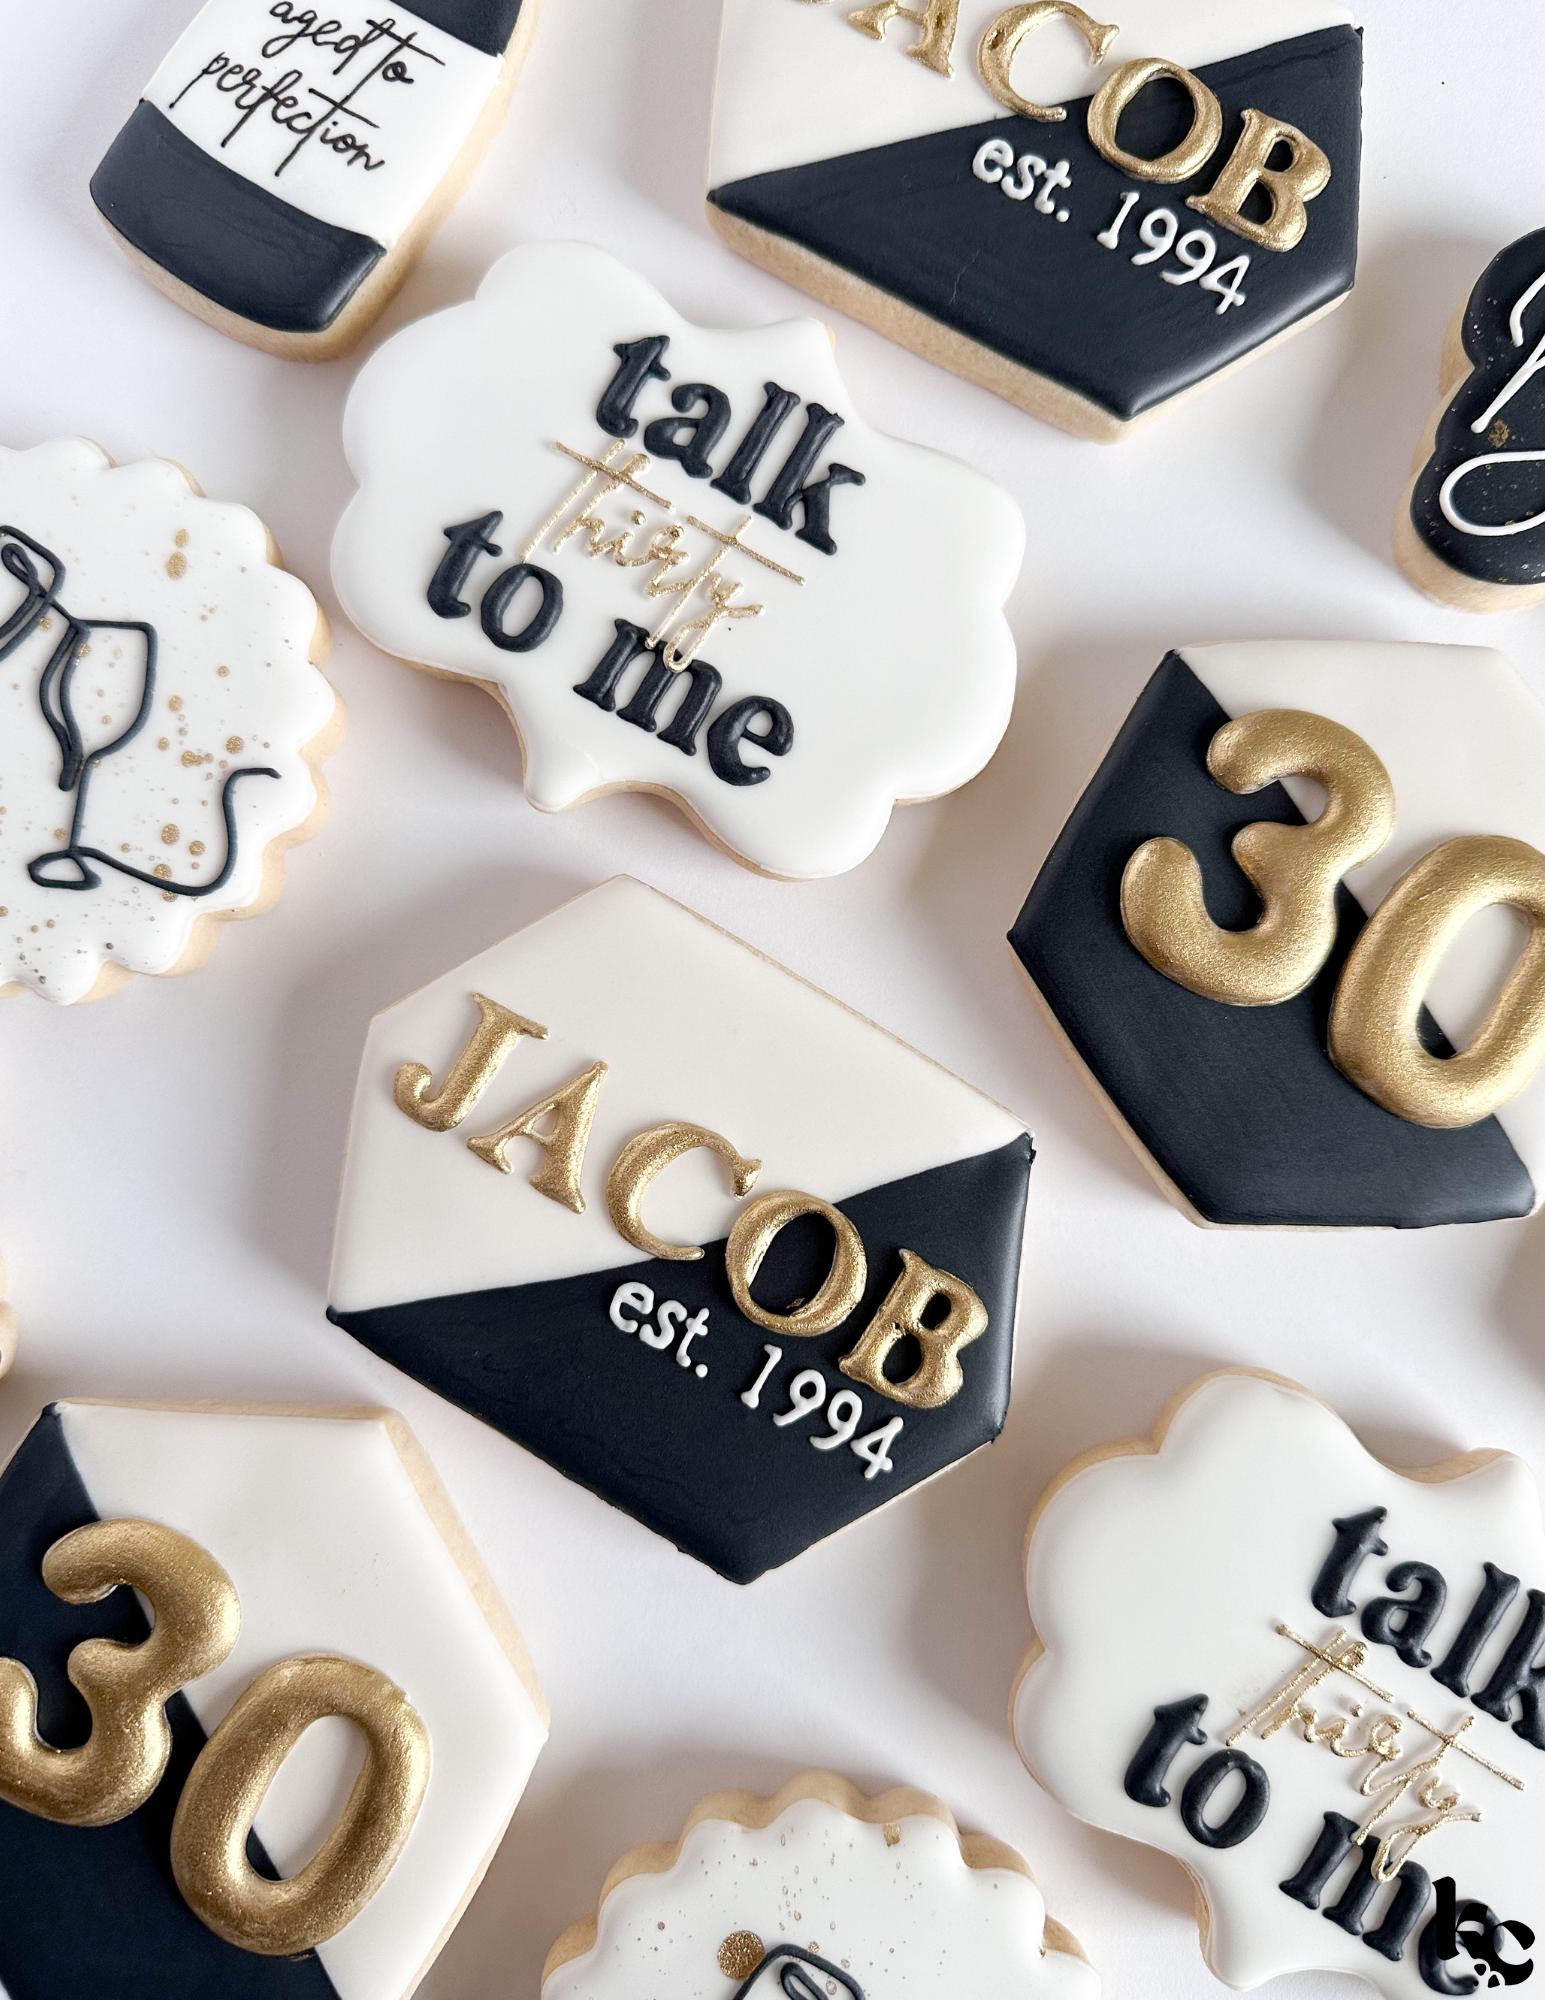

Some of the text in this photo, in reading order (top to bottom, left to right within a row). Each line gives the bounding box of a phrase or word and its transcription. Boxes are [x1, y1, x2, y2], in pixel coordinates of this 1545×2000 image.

[169, 53, 385, 176] perfection
[262, 1, 446, 99] aged to
[793, 0, 1332, 252] ACOB
[972, 139, 1248, 315] est. 1994
[518, 438, 806, 673] thirty
[596, 335, 866, 555] talk
[427, 510, 795, 787] to me
[1120, 709, 1545, 1128] 30
[393, 992, 989, 1409] JACOB
[609, 1281, 904, 1480] est. 1994
[0, 1517, 433, 1958] 30
[1311, 1506, 1545, 1752] talk
[1124, 1693, 1271, 1849] to
[1227, 1622, 1525, 1883] thirty
